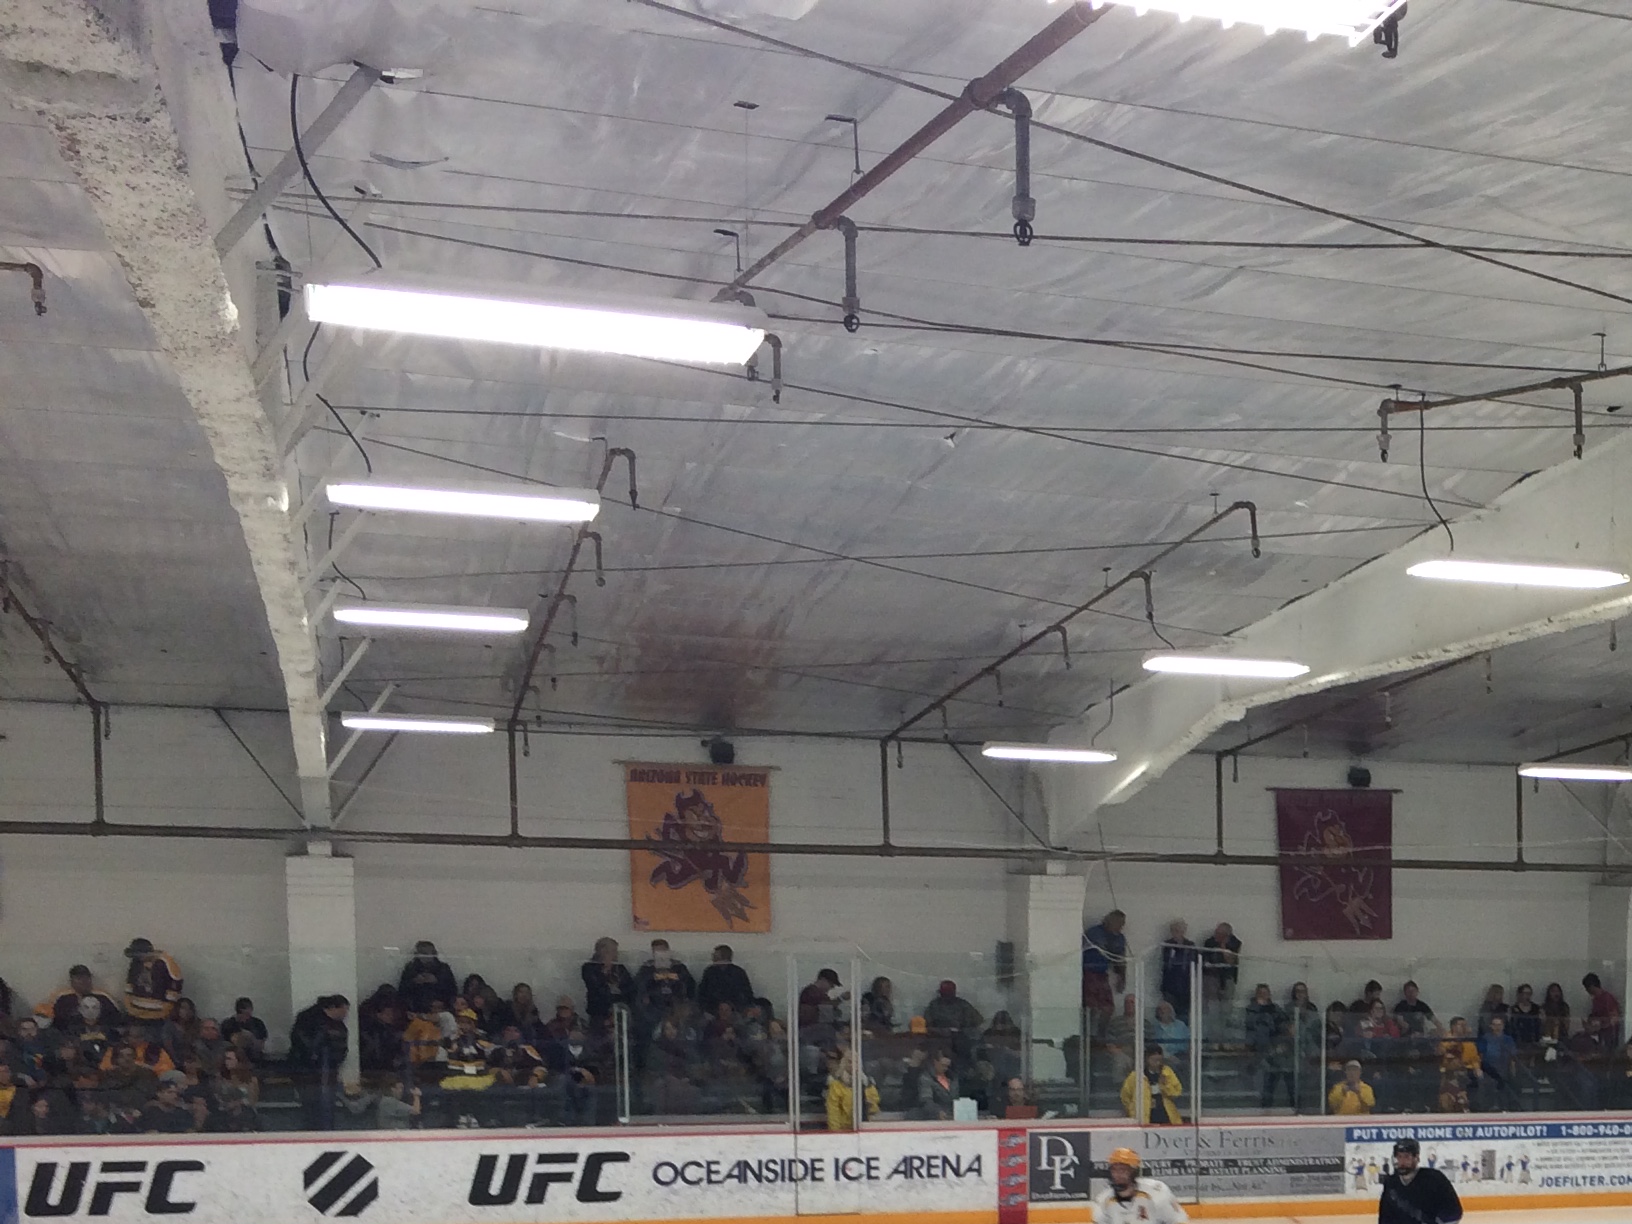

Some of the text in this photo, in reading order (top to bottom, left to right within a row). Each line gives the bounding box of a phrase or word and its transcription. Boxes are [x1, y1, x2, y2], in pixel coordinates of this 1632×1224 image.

[685, 770, 718, 785] STATE
[1219, 1130, 1275, 1149] Ferris
[1353, 1128, 1378, 1140] PUT
[1381, 1127, 1415, 1140] YOUR
[1418, 1126, 1453, 1139] HOME
[1456, 1126, 1474, 1138] ON
[1476, 1125, 1548, 1138] AUTOPILOT!
[467, 1150, 631, 1207] UFC
[653, 1153, 983, 1187] OCEANSIDE ICE ARENA
[23, 1159, 206, 1218] UFC
